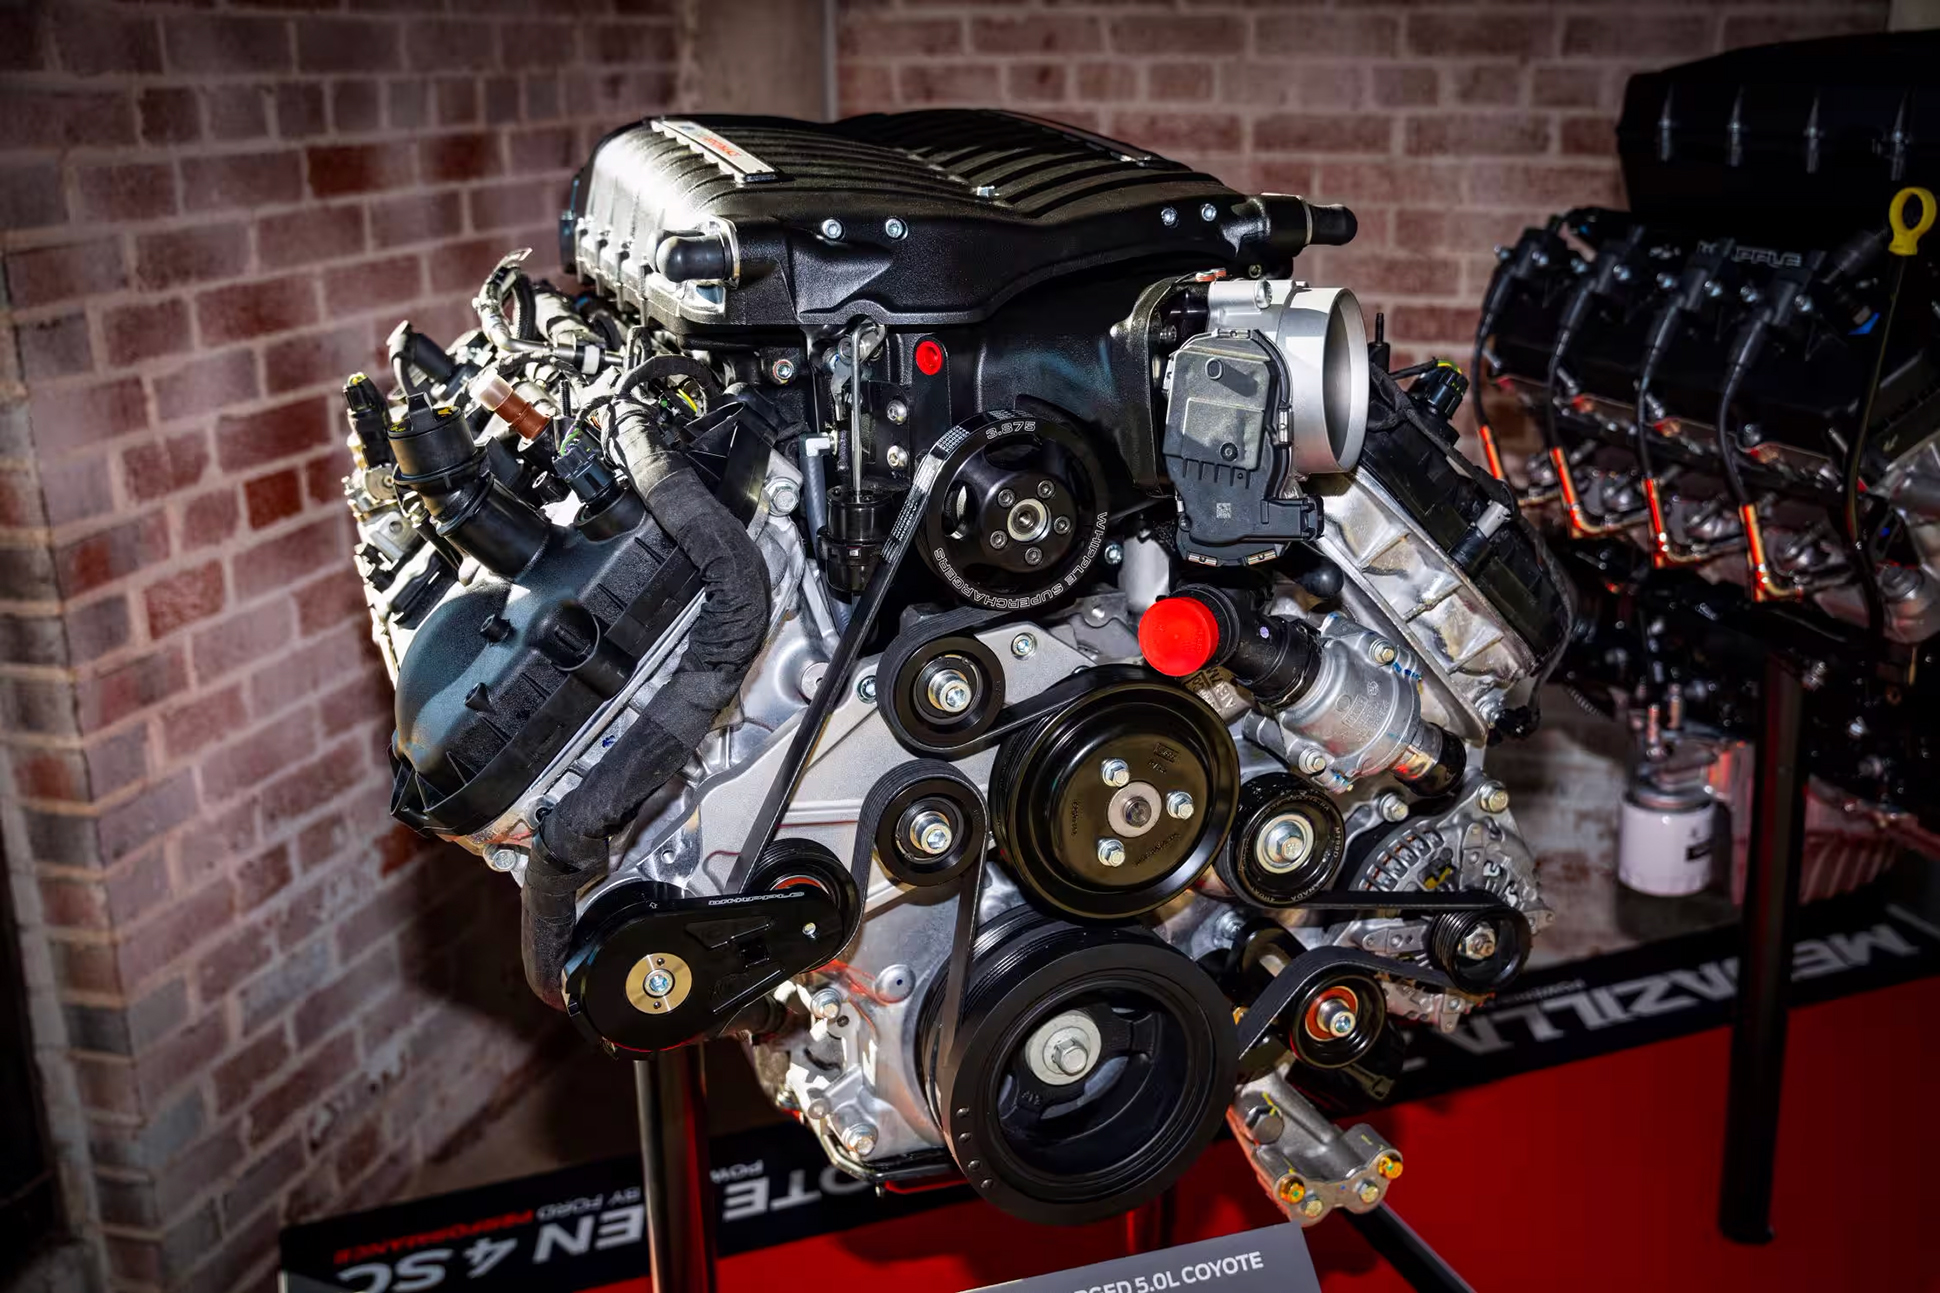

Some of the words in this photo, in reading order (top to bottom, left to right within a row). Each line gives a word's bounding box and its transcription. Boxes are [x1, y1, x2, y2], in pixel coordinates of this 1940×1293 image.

[986, 421, 1036, 440] 3.875
[1064, 511, 1108, 586] WHIPPLE
[933, 547, 1064, 609] SUPERCHARGERS
[1436, 924, 1920, 1055] MEAZILLA
[536, 1194, 603, 1220] FORD
[608, 1187, 641, 1206] BY
[333, 1209, 534, 1264] PERFORMANCE
[463, 1237, 518, 1279] 4
[533, 1204, 645, 1264] EN
[1134, 1270, 1181, 1293] 5.0L
[1181, 1251, 1265, 1284] COYOTE
